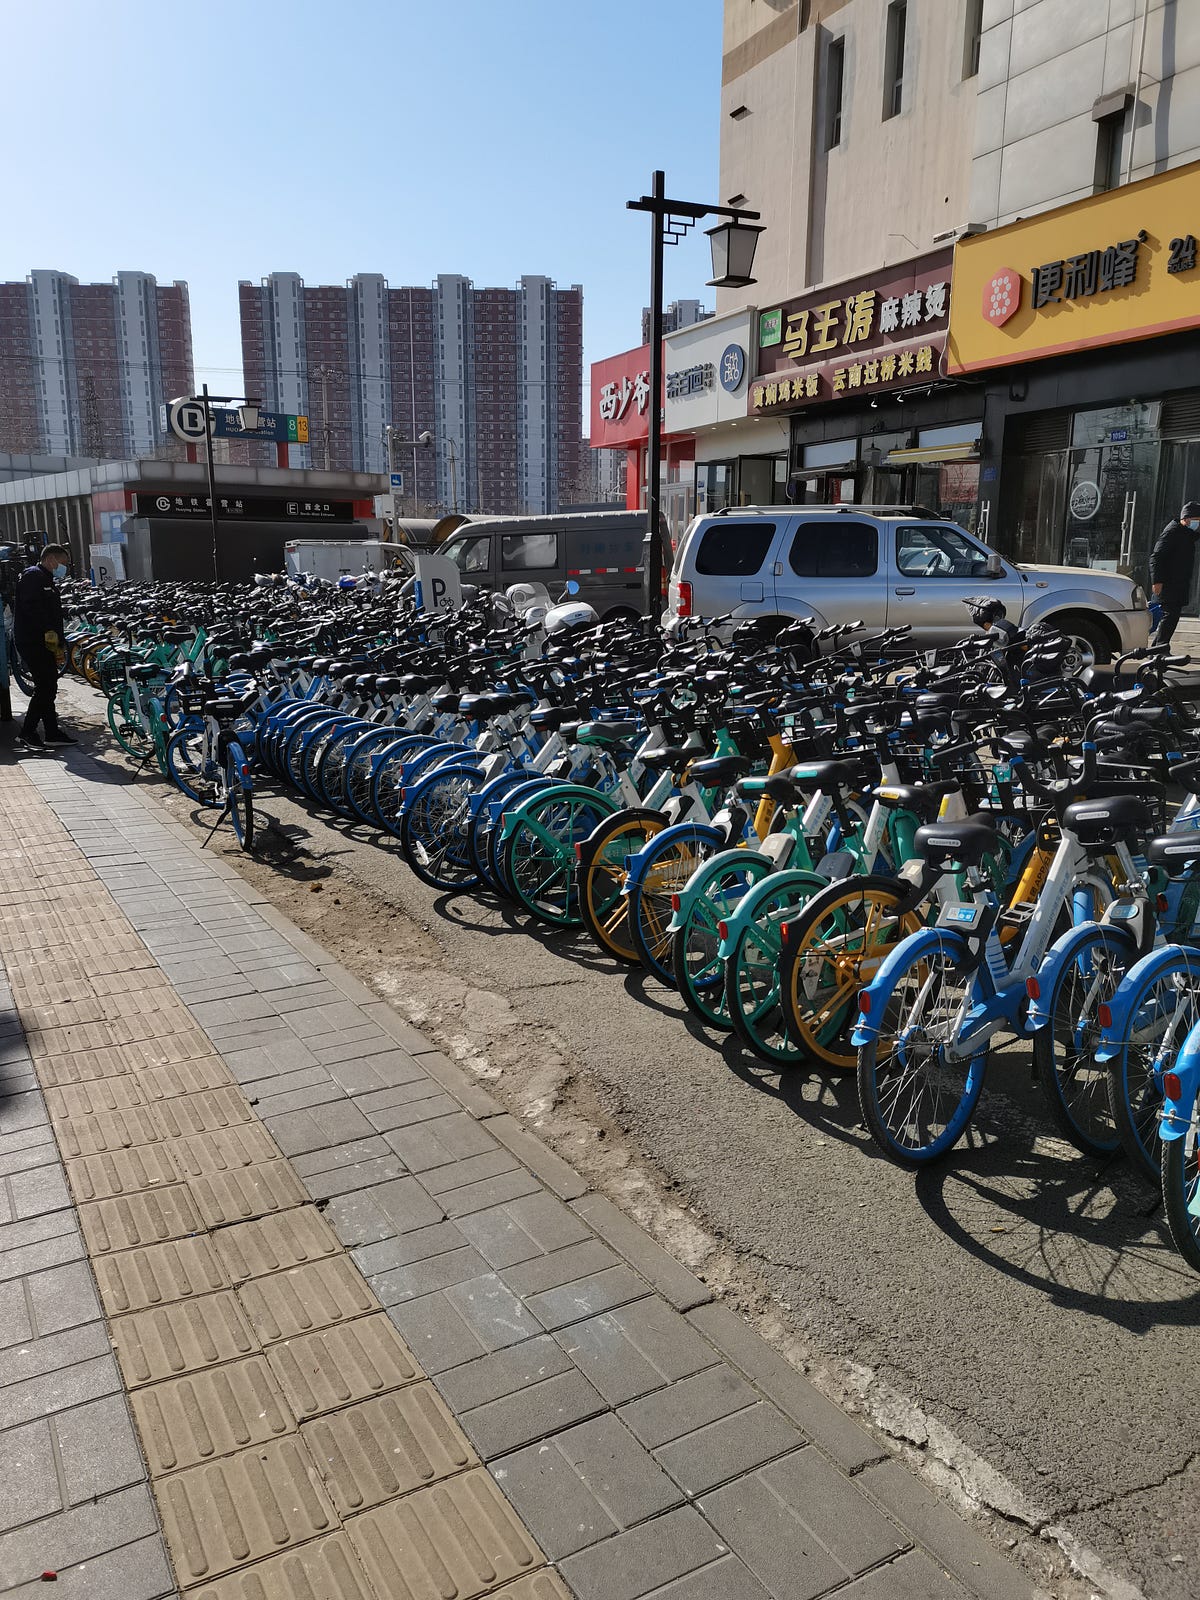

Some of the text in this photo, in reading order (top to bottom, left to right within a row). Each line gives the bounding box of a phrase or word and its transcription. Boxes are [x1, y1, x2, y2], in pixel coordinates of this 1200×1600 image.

[1169, 234, 1197, 264] 24
[1031, 239, 1140, 310] 便利蜂
[879, 281, 947, 334] 麻辣烫
[782, 290, 877, 359] 马王涛
[724, 351, 739, 367] CHA
[832, 345, 933, 393] 云南过桥米线
[666, 364, 704, 399] 茶百道
[724, 367, 740, 383] DAO
[752, 373, 820, 409] 黄焖鸡米饭
[289, 419, 296, 431] 8
[298, 420, 308, 432] 13
[305, 503, 329, 511] 西北口
[99, 566, 108, 581] P
[431, 578, 447, 608] P
